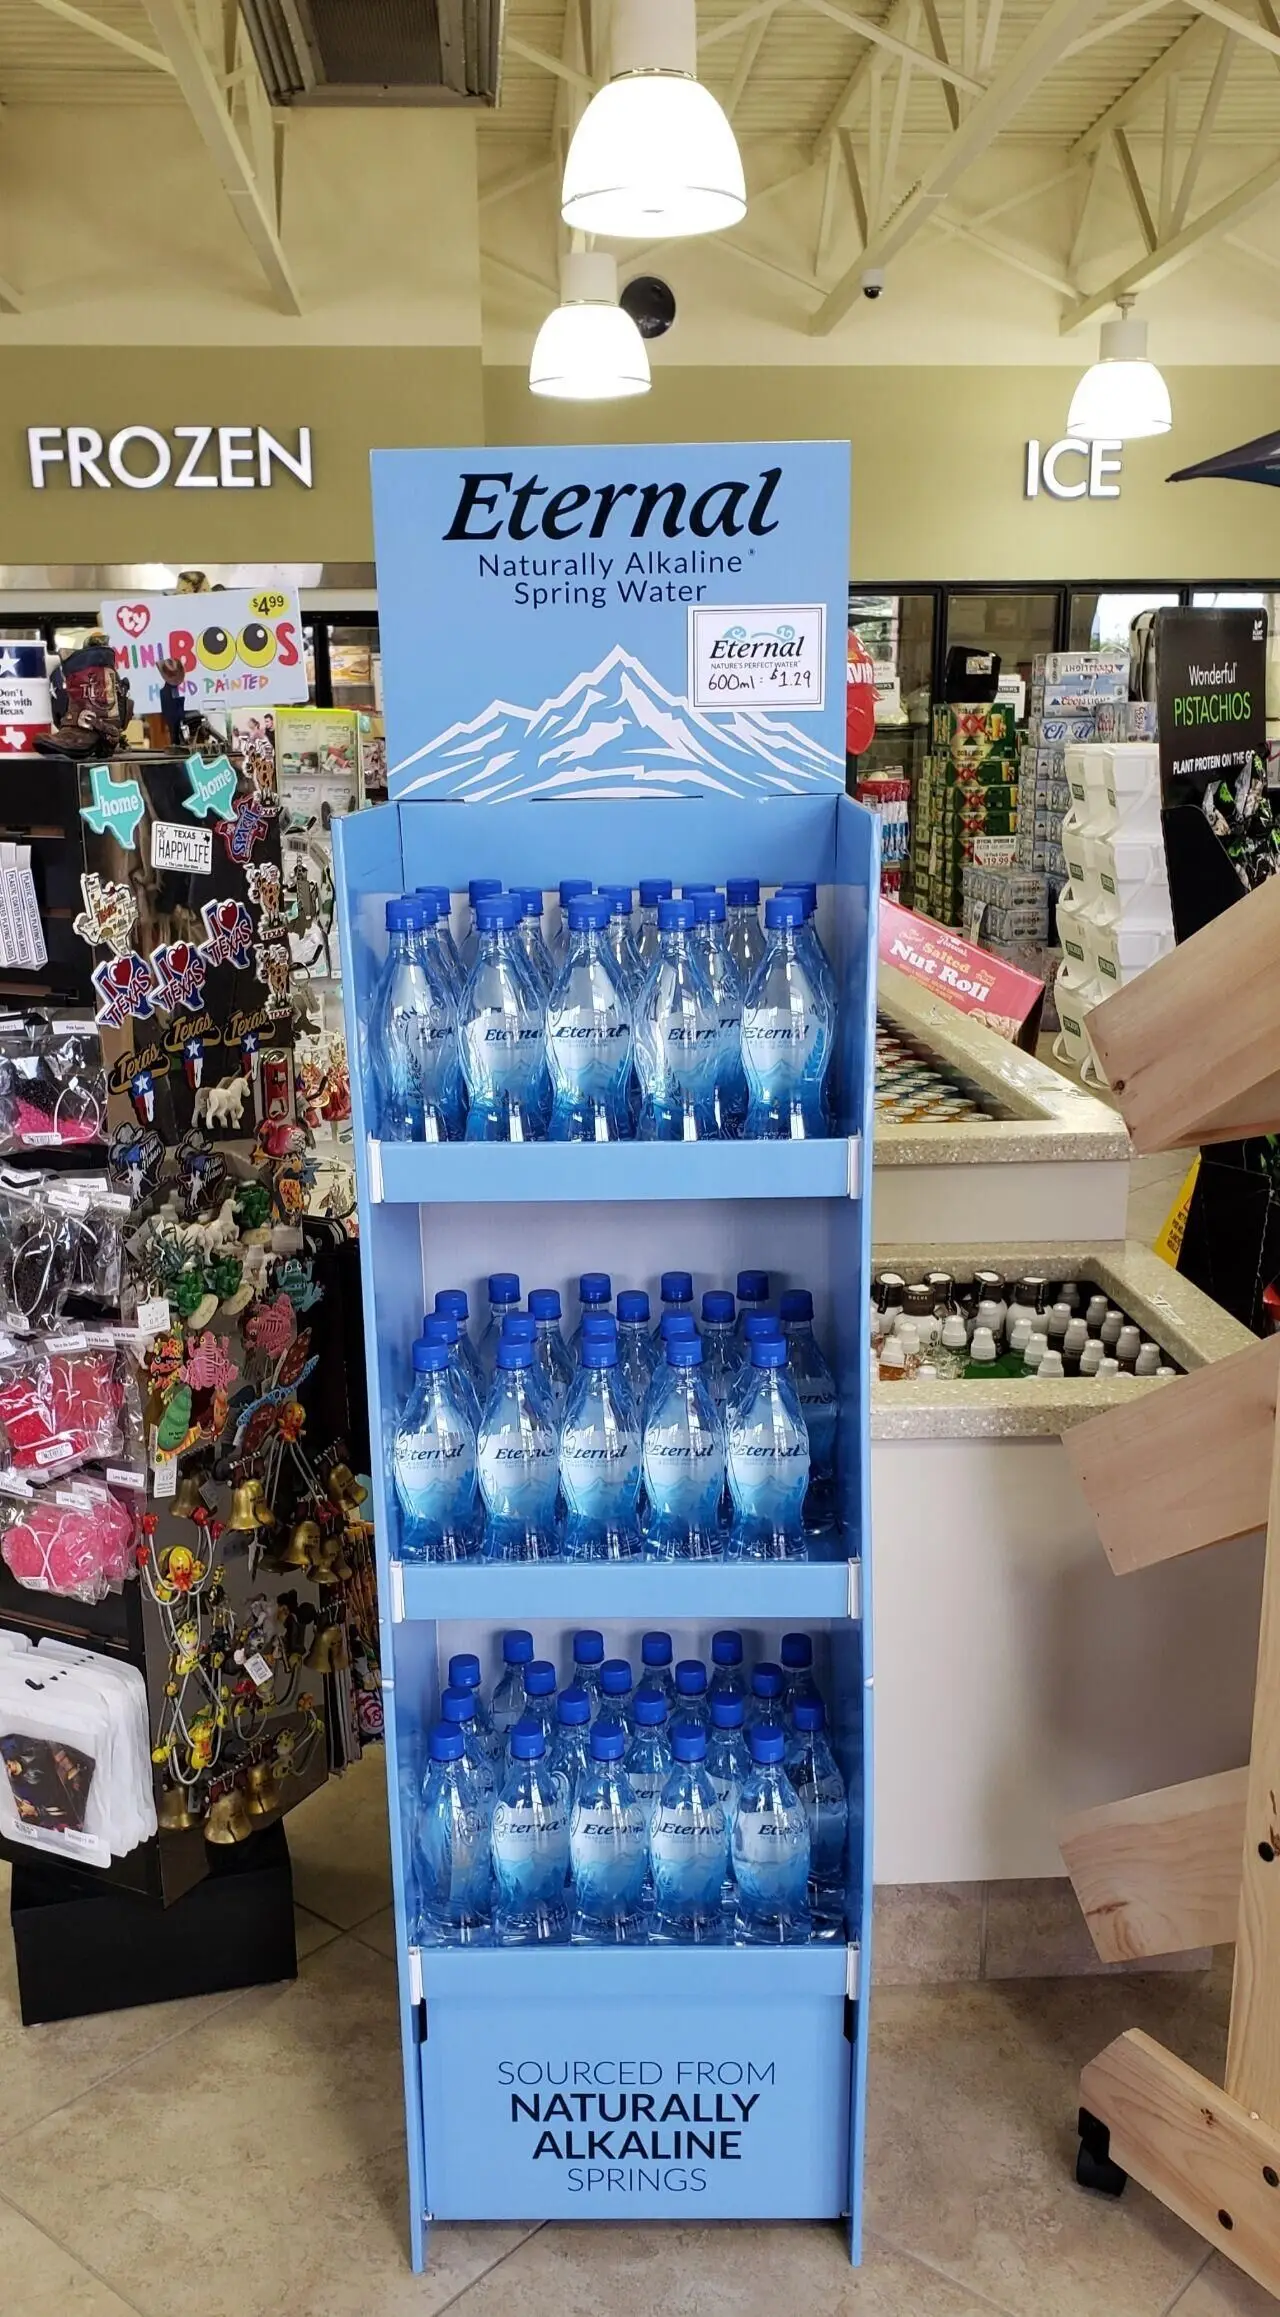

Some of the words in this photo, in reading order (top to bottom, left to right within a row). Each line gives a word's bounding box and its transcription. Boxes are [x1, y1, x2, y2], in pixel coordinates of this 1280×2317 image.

[27, 425, 312, 488] FROZEN
[1026, 438, 1123, 498] ICE
[442, 467, 783, 541] Eternal
[478, 552, 613, 581] Naturally
[624, 550, 743, 576] Alkaline
[513, 580, 607, 609] Spring
[617, 580, 707, 603] Water
[118, 607, 147, 632] ty
[112, 642, 165, 669] MINI
[709, 636, 805, 659] Eternal
[744, 661, 773, 669] PERFECT
[1188, 661, 1237, 687] Wonderful
[149, 680, 198, 701] HND
[708, 673, 755, 691] 600ml
[769, 668, 811, 688] $1.29
[13, 698, 33, 706] with
[1174, 691, 1251, 727] PISTACHIOS
[1172, 759, 1194, 775] PLANT
[1194, 755, 1222, 772] PROTEIN
[1221, 753, 1232, 767] ON
[1233, 751, 1245, 765] THE
[199, 768, 232, 800] home
[99, 793, 139, 818] home
[173, 829, 197, 840] TEXAS
[158, 838, 210, 864] HAPPYLIFE
[208, 920, 252, 965] TEXAS
[262, 927, 287, 939] TEXAS
[889, 939, 937, 974] Nut
[938, 965, 990, 1002] Roll
[923, 942, 971, 974] Salted
[107, 968, 151, 1026] TEXAS
[160, 958, 206, 1011] TEXAS
[173, 1012, 213, 1040] Texas
[231, 1008, 268, 1036] Texas
[117, 1043, 159, 1079] Texas
[497, 2060, 663, 2086] SOURCED
[676, 2060, 776, 2086] FROM
[511, 2093, 761, 2123] NATURALLY
[532, 2130, 742, 2160] ALKALINE
[567, 2167, 707, 2193] SPRINGS
